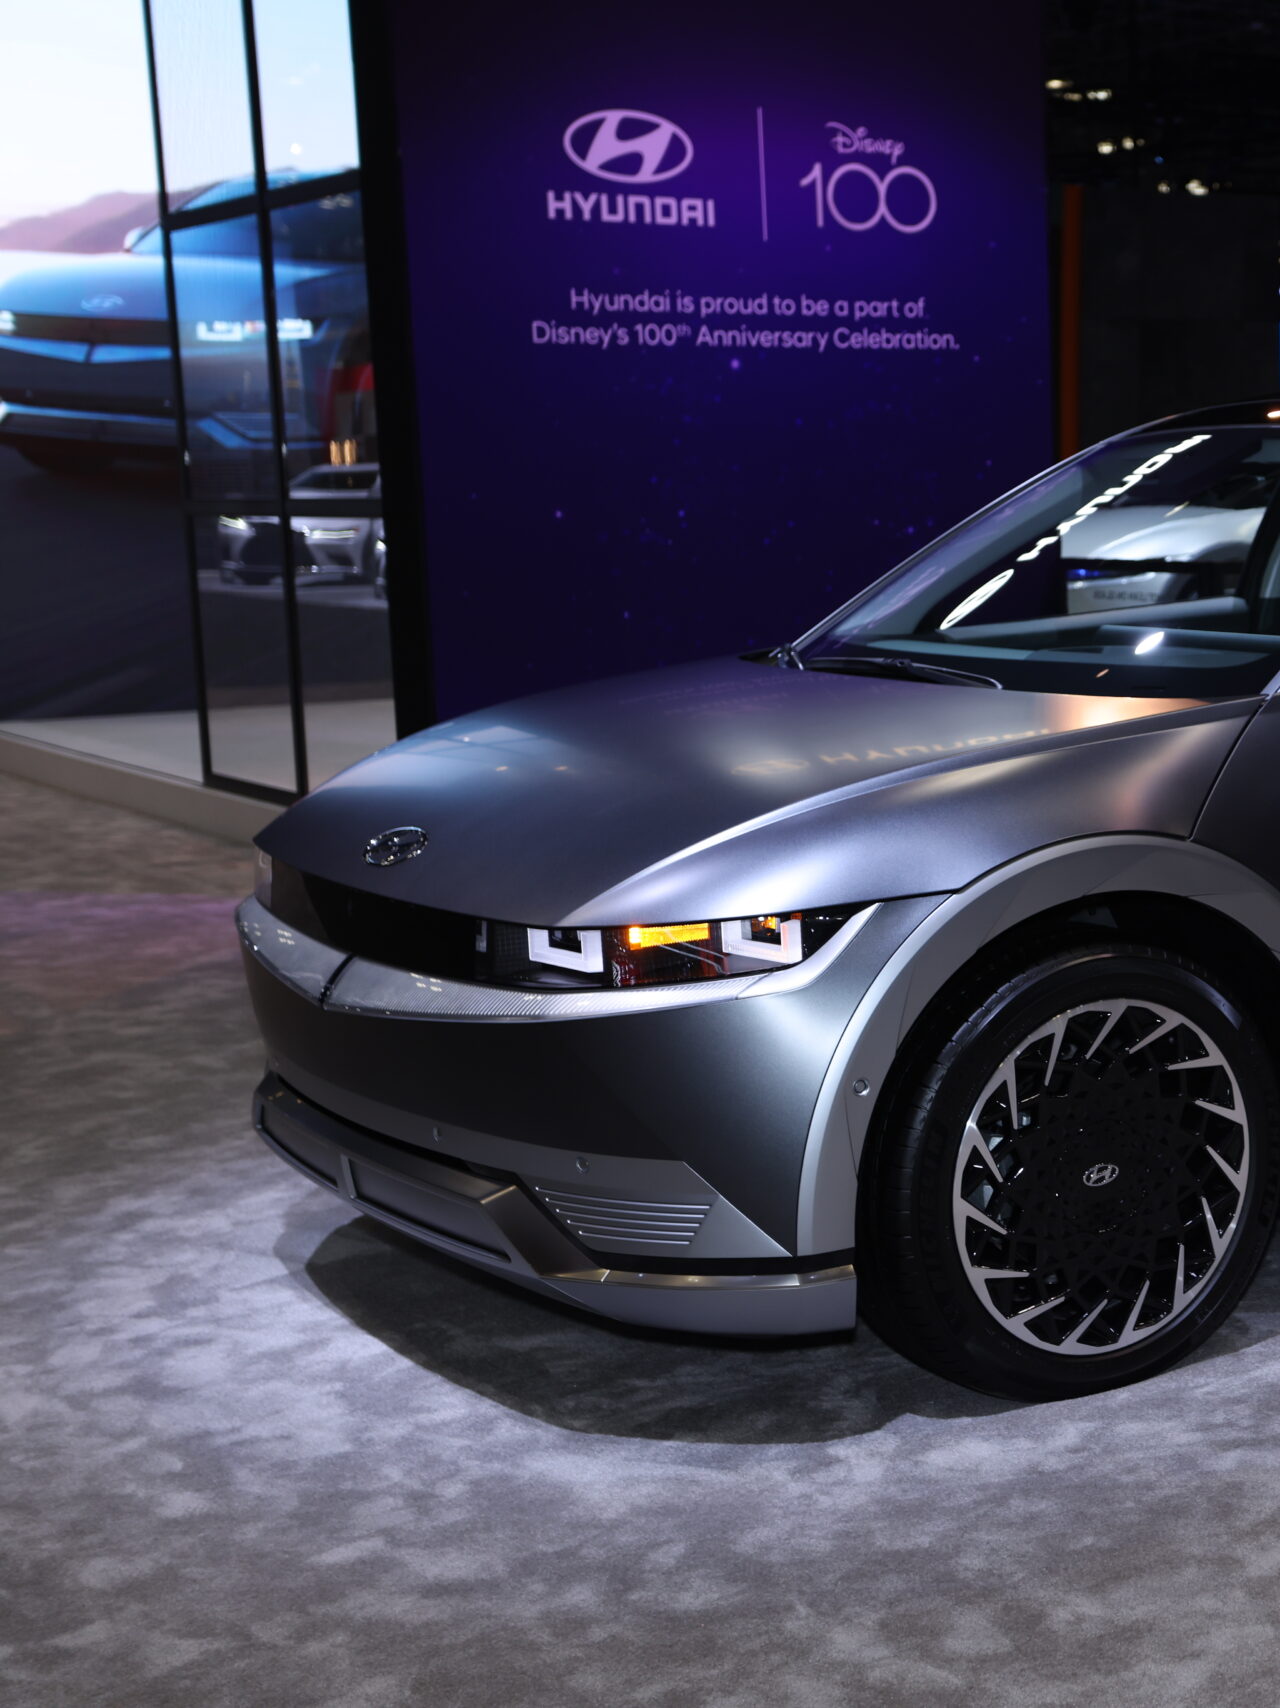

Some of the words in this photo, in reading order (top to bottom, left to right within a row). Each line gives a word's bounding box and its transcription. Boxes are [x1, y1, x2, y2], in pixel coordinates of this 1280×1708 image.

[825, 121, 904, 165] Disney
[546, 190, 716, 228] HYUNDAI
[799, 161, 938, 233] 100
[570, 287, 671, 316] Hyundai
[676, 289, 695, 313] is
[699, 293, 768, 318] proud
[773, 295, 796, 315] to
[800, 294, 830, 316] be
[833, 299, 849, 316] a
[854, 299, 900, 321] part
[903, 296, 926, 318] of
[532, 320, 630, 349] Disney's
[634, 323, 692, 346] 100th
[696, 324, 829, 352] Anniversary
[832, 327, 960, 350] Celebration.
